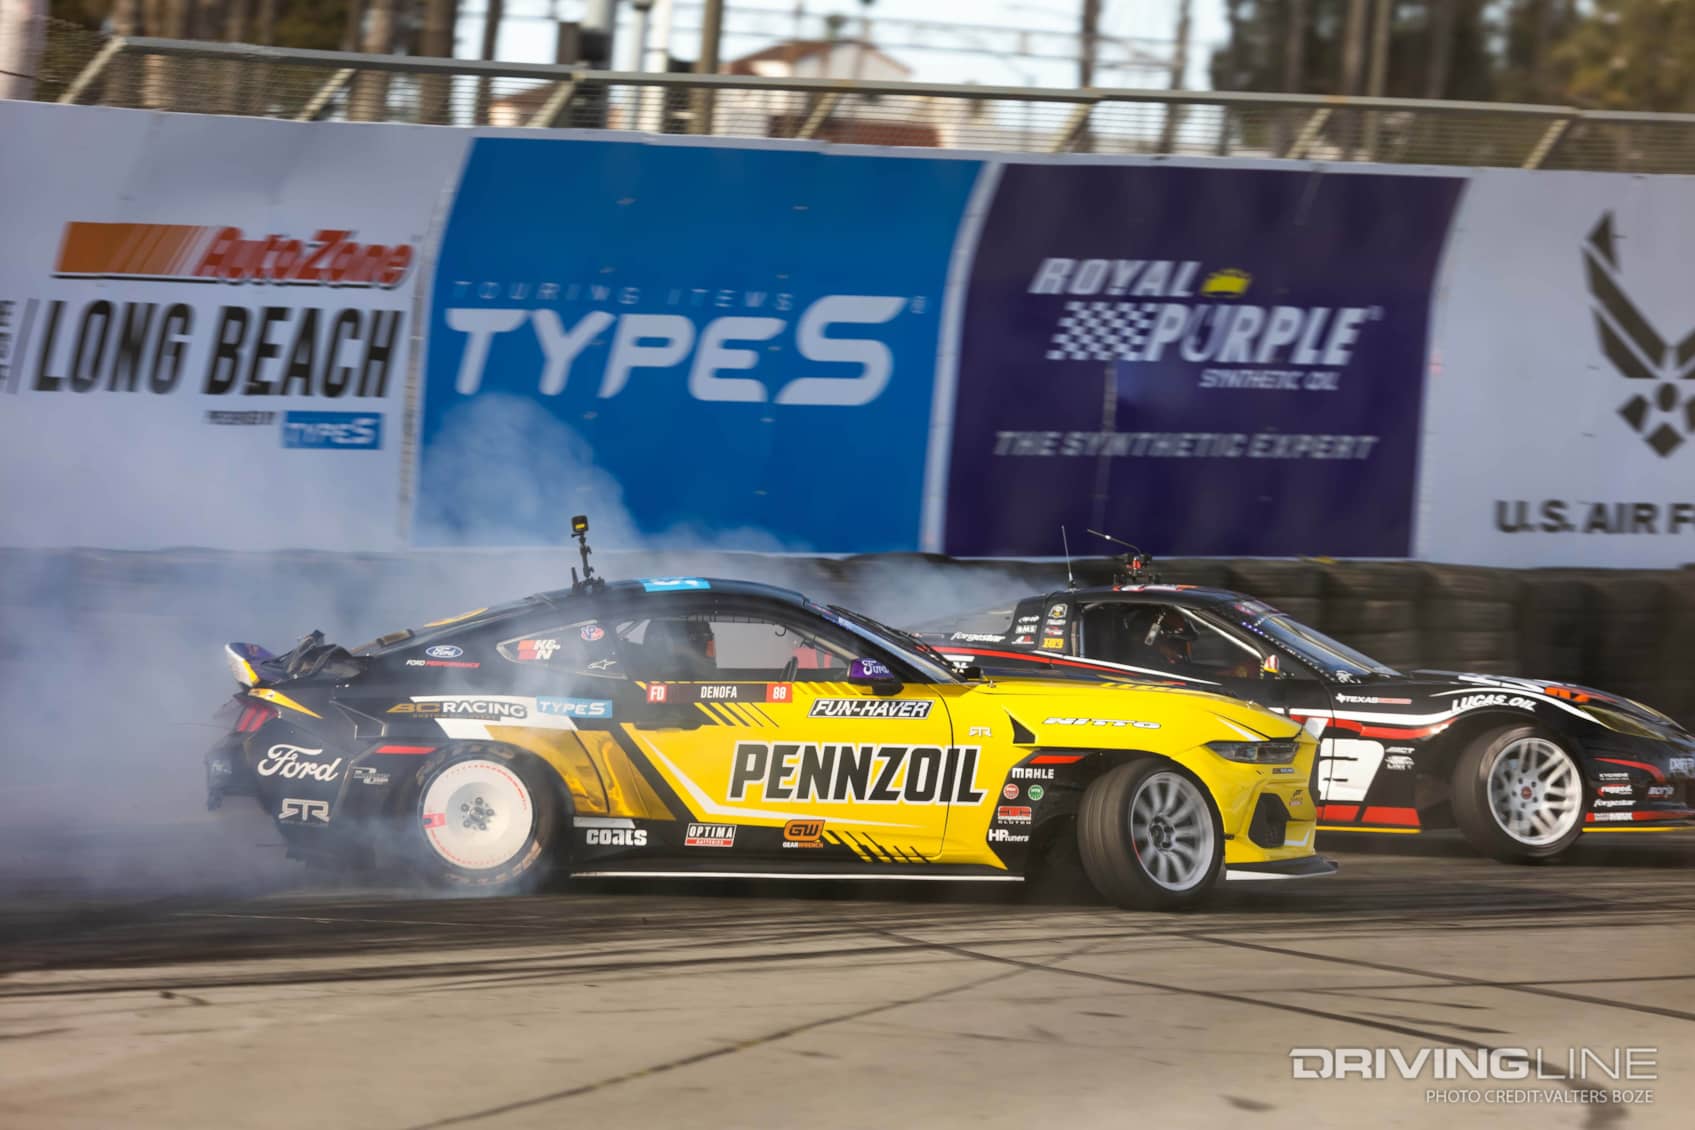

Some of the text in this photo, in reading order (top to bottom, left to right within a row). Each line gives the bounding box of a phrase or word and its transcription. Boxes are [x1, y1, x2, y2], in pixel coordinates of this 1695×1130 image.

[192, 227, 413, 284] AutoZone
[1028, 258, 1201, 297] ROYAL
[455, 281, 640, 305] TOURING
[1144, 302, 1367, 366] PURPLE
[32, 300, 195, 394] LONG
[201, 306, 405, 398] BEACH
[1199, 369, 1341, 390] SYNTHETIC OIL
[993, 432, 1380, 459] THE SYNTHETIC EXPERT
[1494, 499, 1576, 534] U.S.
[1582, 502, 1660, 535] AIR
[650, 686, 787, 700] FD DENOFA 88
[1451, 694, 1538, 713] LUCAS OIL
[442, 701, 527, 718] RACING
[811, 700, 932, 717] FUN-HAVER
[1043, 717, 1161, 729] NITTO
[257, 744, 343, 782] Ford
[728, 741, 987, 805] PENNZOIL
[1012, 768, 1055, 779] MAHLE
[278, 798, 330, 822] RTR
[689, 826, 733, 838] OPTIMA
